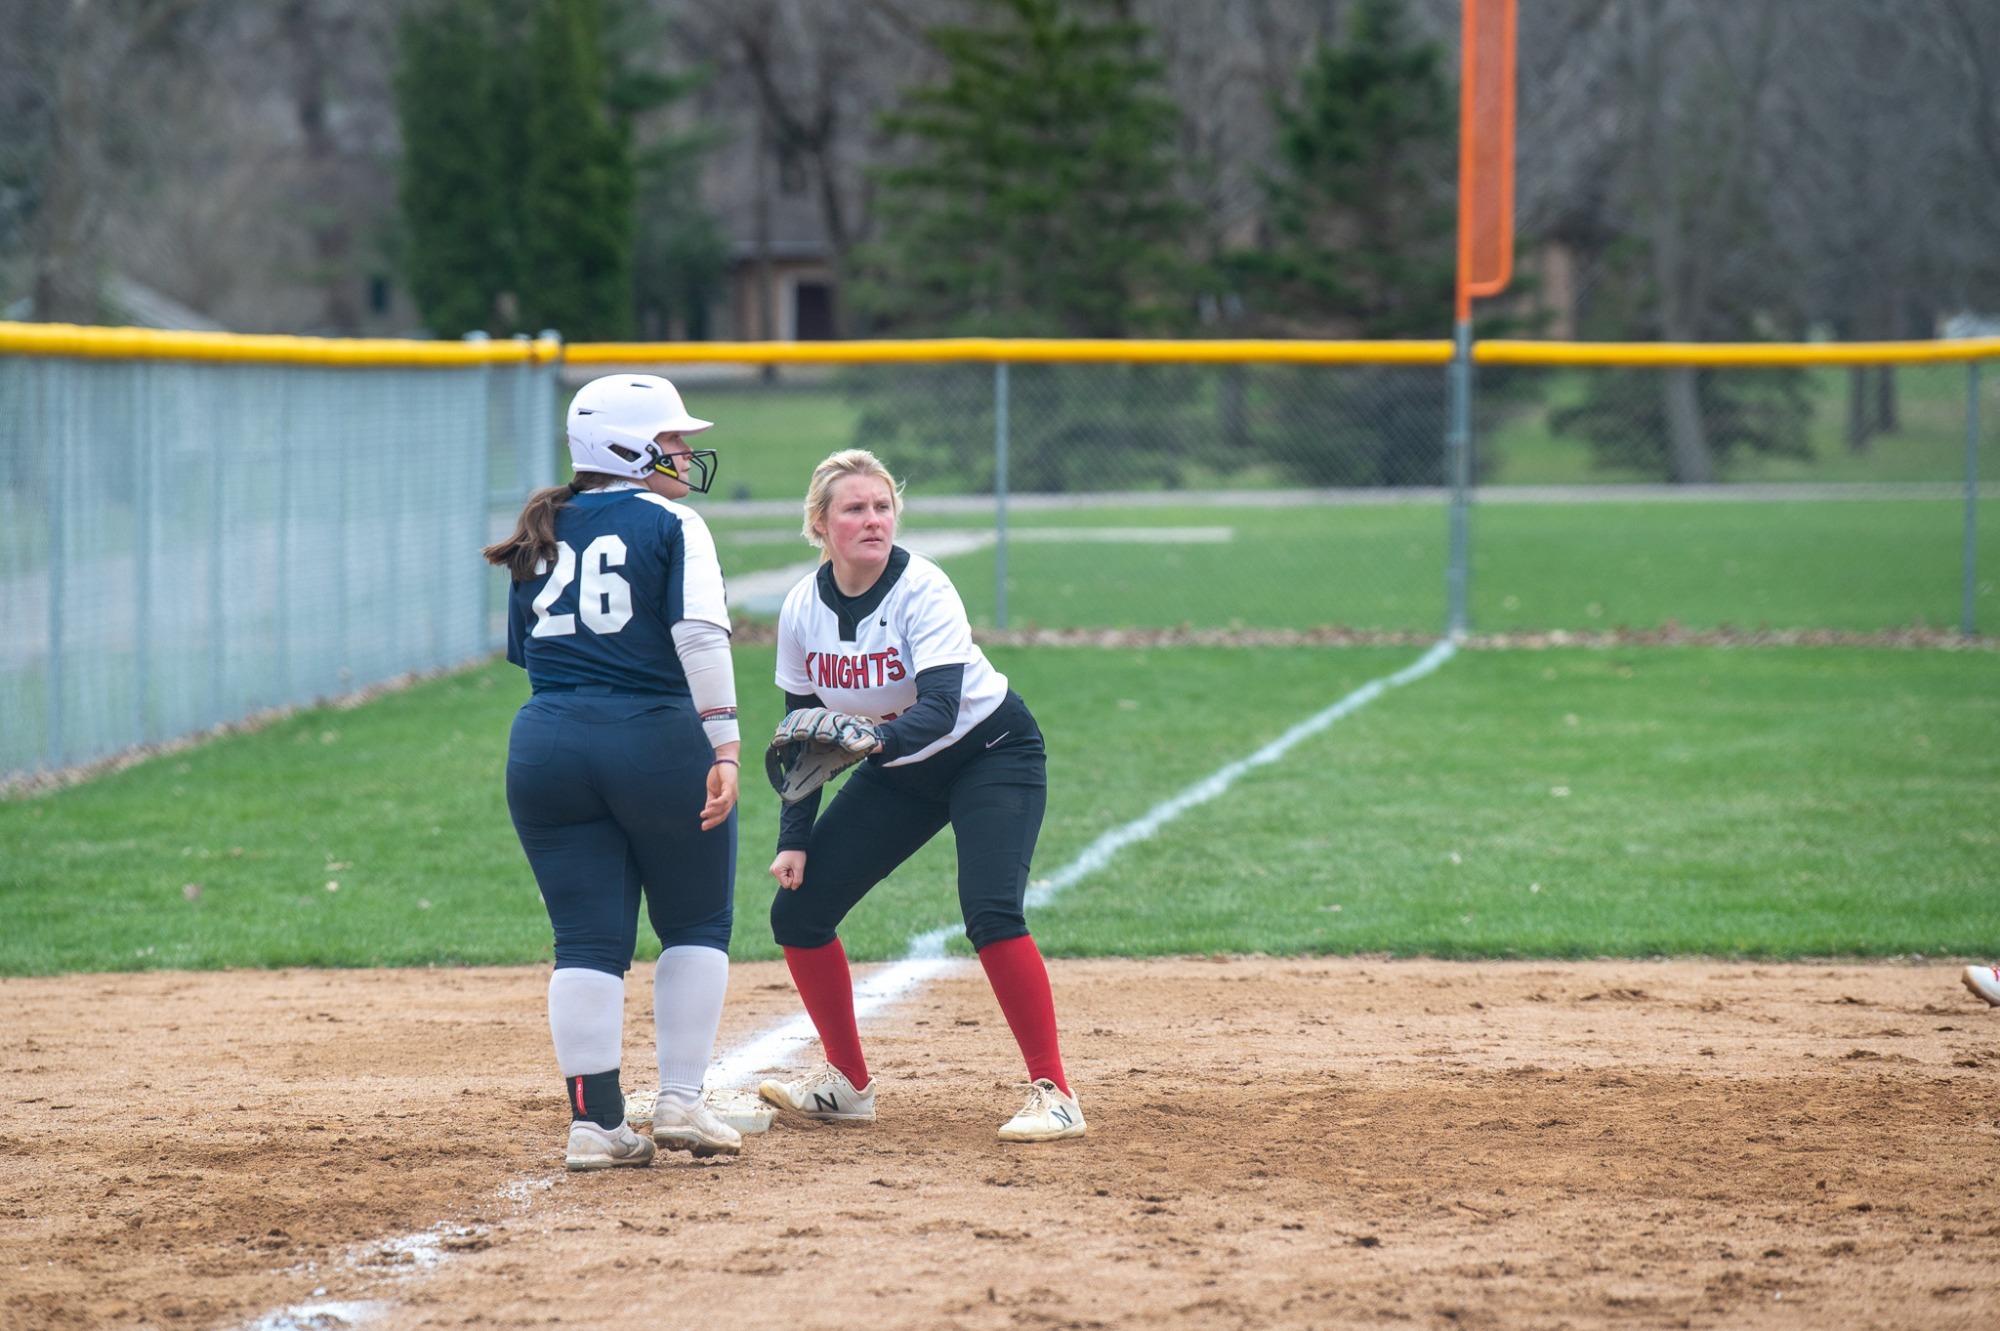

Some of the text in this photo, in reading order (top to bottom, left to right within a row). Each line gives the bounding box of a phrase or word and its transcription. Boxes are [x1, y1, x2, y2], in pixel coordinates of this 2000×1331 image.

[531, 534, 634, 638] 26
[812, 1092, 839, 1112] N
[1051, 1105, 1073, 1128] N
